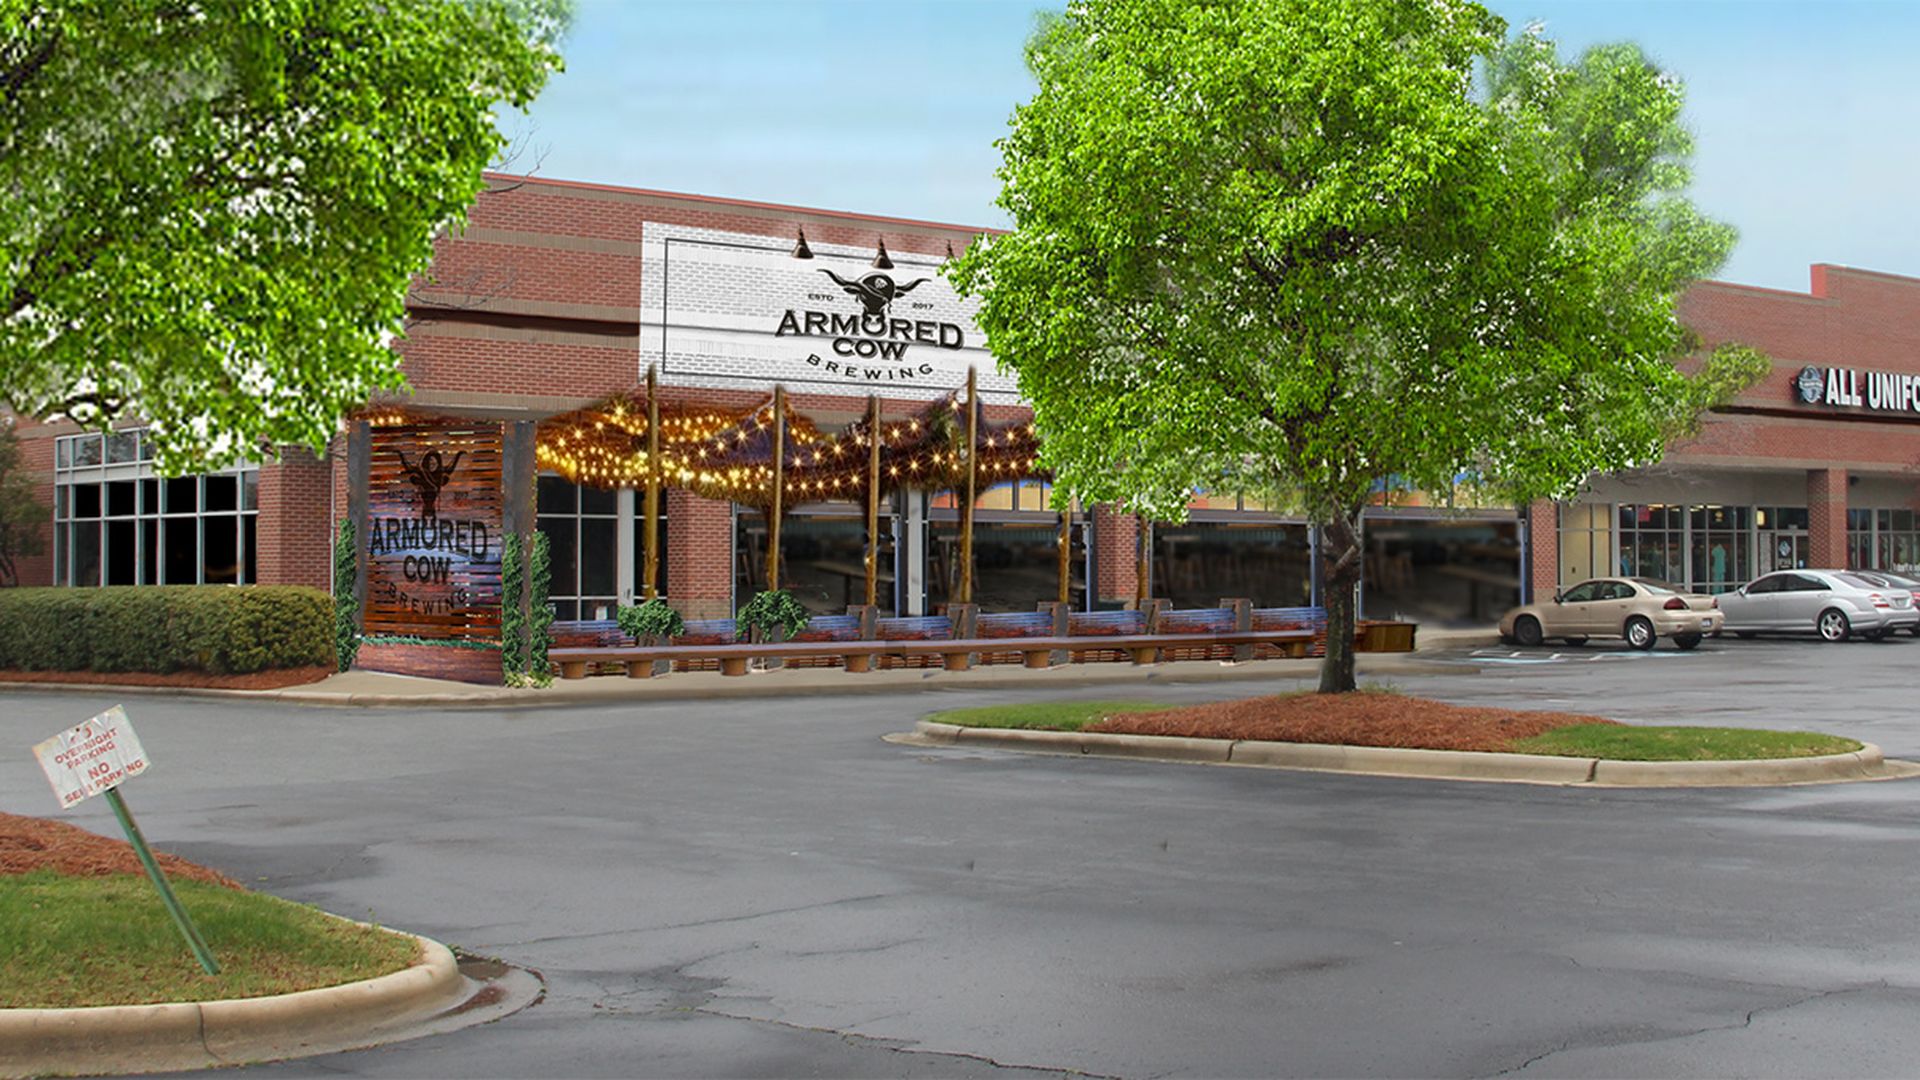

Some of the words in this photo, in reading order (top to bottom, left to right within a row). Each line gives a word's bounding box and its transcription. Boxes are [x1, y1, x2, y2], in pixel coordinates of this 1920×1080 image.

[912, 302, 934, 310] 2017
[775, 309, 964, 350] ARMORED
[832, 337, 909, 361] COW
[806, 353, 934, 380] BREWING
[1825, 367, 1862, 407] ALL
[370, 518, 488, 562] ARMORED
[403, 555, 450, 583] COW
[388, 583, 466, 615] BREWING
[55, 727, 118, 764] OVERNIGHT
[66, 741, 116, 769] PARKING
[88, 762, 110, 779] NO
[95, 759, 143, 788] PARKNG
